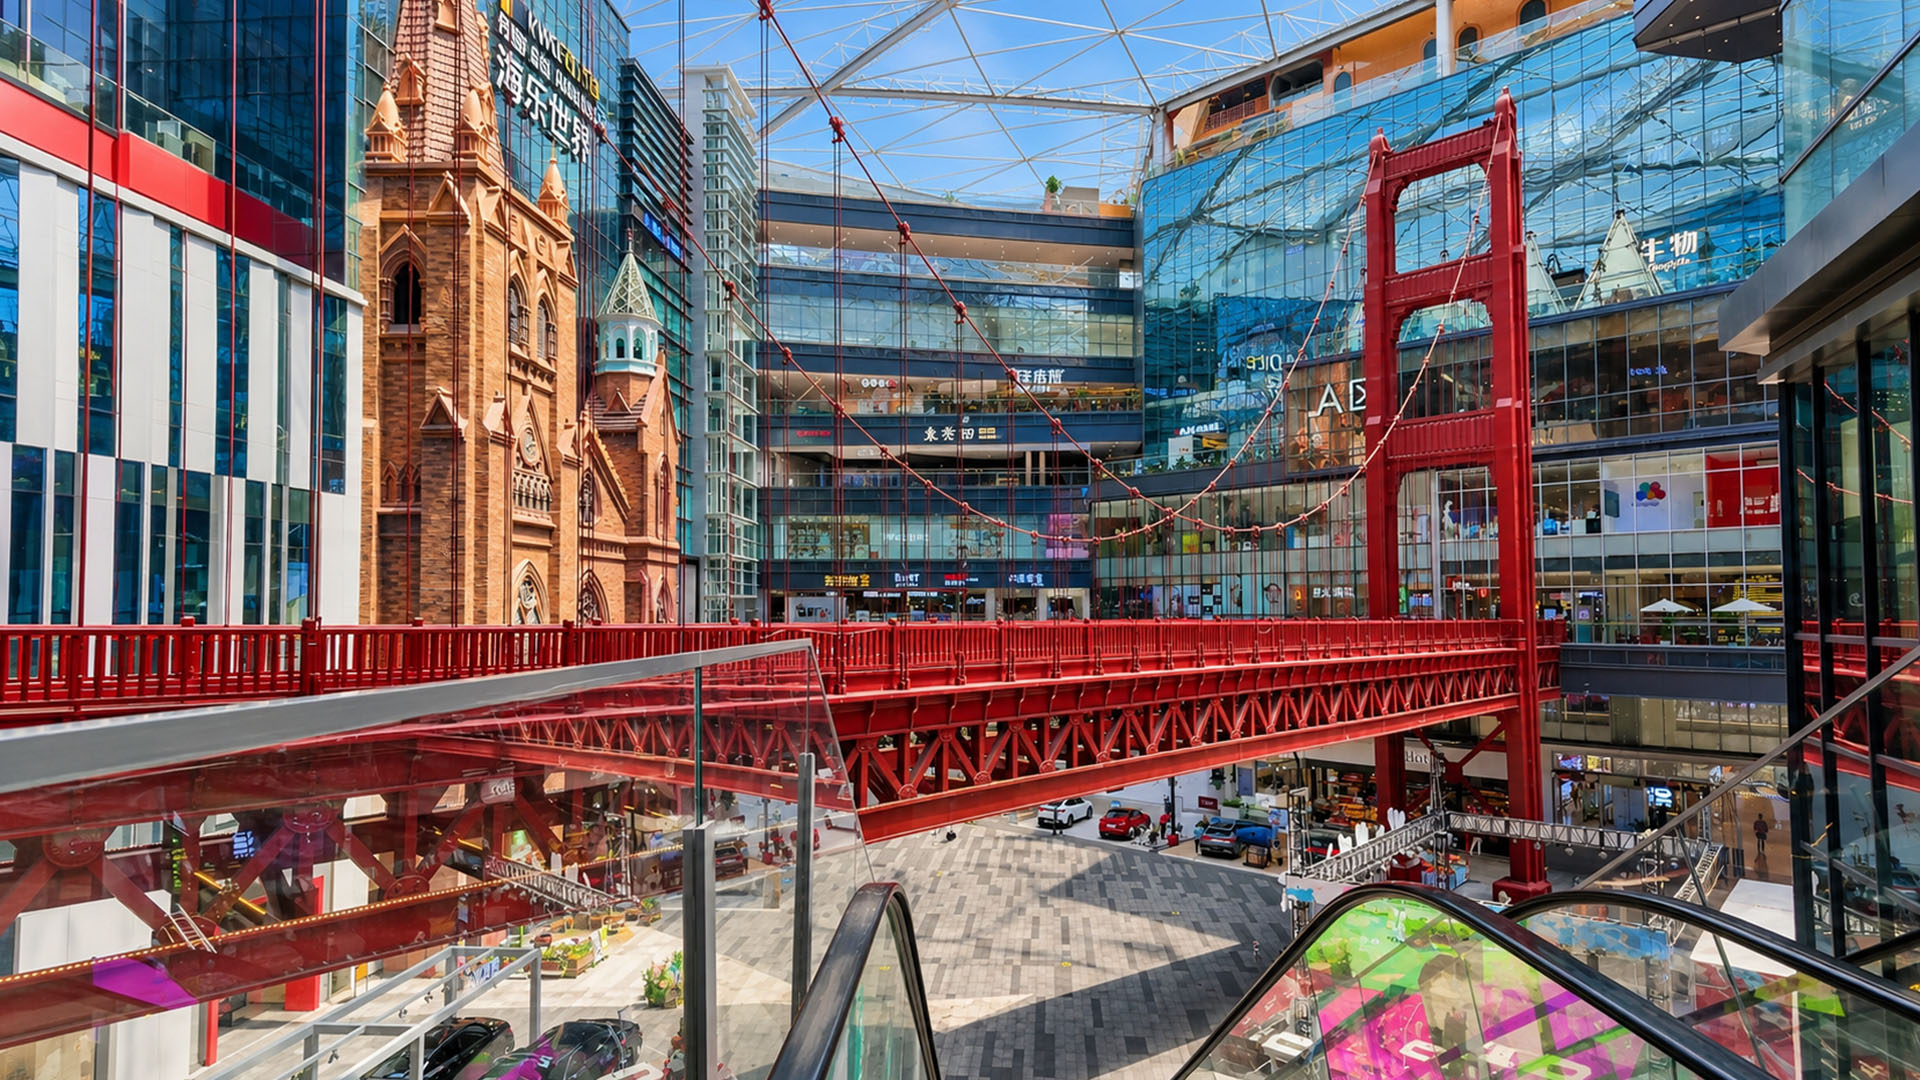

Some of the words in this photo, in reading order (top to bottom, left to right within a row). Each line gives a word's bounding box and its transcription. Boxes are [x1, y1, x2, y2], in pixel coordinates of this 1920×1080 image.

[496, 42, 590, 163] 海乐世界
[1640, 230, 1698, 262] 生物
